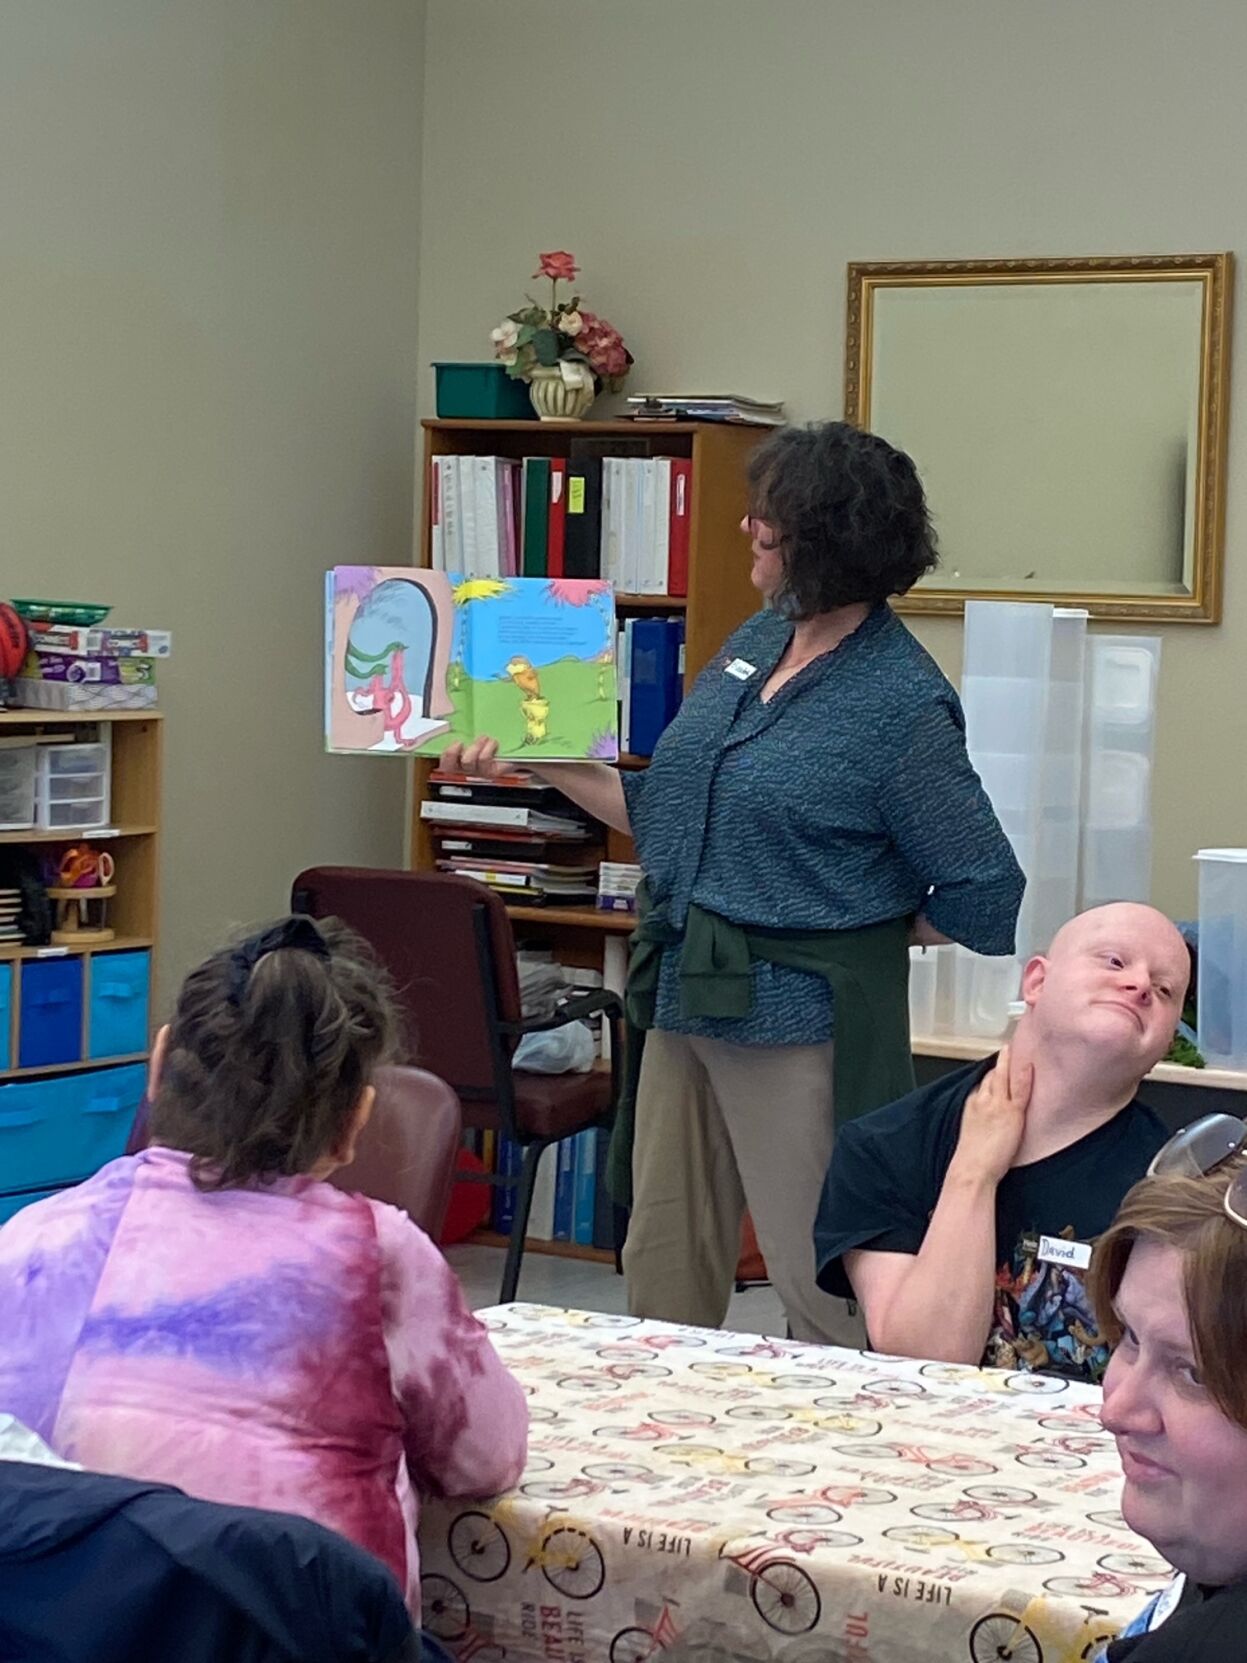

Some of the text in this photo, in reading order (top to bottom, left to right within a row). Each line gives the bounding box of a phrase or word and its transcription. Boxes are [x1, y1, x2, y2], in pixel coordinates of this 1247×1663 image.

[1041, 1238, 1076, 1259] David
[623, 1526, 692, 1557] LIFE IS A
[877, 1573, 952, 1606] LIFE IS A
[565, 1610, 585, 1646] LIFE
